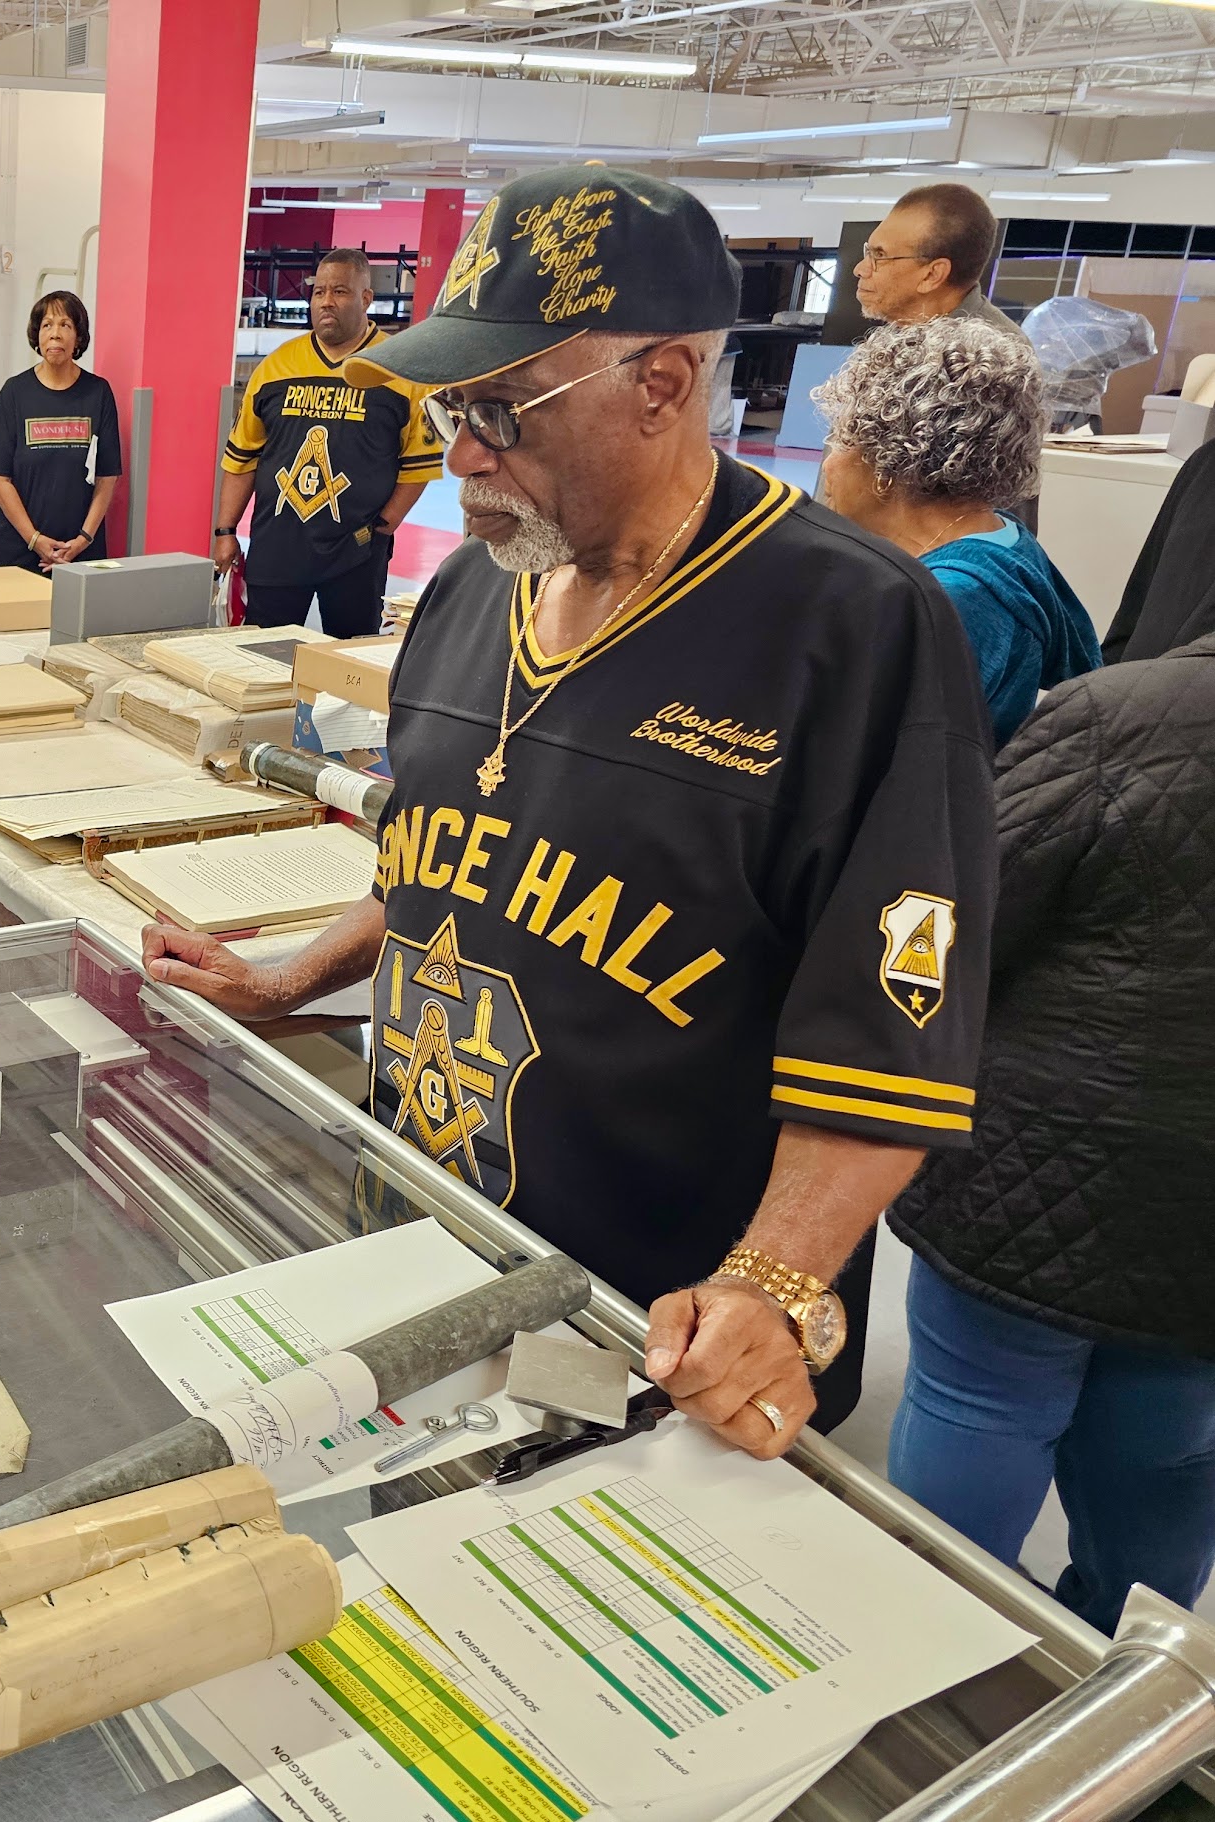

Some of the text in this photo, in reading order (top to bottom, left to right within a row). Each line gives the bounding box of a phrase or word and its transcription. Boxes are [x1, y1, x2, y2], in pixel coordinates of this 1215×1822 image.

[513, 187, 617, 241] Light from
[529, 230, 565, 257] the
[537, 232, 599, 276] Faith
[551, 264, 603, 296] Hope
[539, 285, 618, 325] Charity
[284, 385, 367, 413] PRINCE HALL
[302, 409, 345, 420] MASON
[298, 465, 319, 496] G
[655, 701, 778, 752] Worldwide
[630, 719, 783, 776] Brotherhood
[382, 805, 512, 906] RINCE
[504, 837, 726, 1028] HALL
[418, 1067, 448, 1124] G
[174, 1375, 203, 1402] REGION
[276, 1664, 291, 1679] RET
[452, 1627, 542, 1714] SOUTHERN REGION
[308, 1695, 329, 1716] SCANN
[595, 1690, 622, 1716] LODGE
[337, 1725, 352, 1740] INT
[505, 1738, 517, 1749] 48
[519, 1735, 541, 1756] Lodge
[269, 1742, 313, 1788] REGION
[357, 1745, 373, 1761] REC
[419, 1715, 516, 1807] Lodge #2 Done
[428, 1709, 540, 1814] Lodge #72 Done
[520, 1751, 545, 1774] Lodge
[539, 1754, 562, 1776] Evans
[653, 1743, 689, 1777] DISTRICT
[512, 1773, 537, 1796] Lodge
[544, 1771, 589, 1814] Chesapeake
[568, 1779, 599, 1808] Andrew
